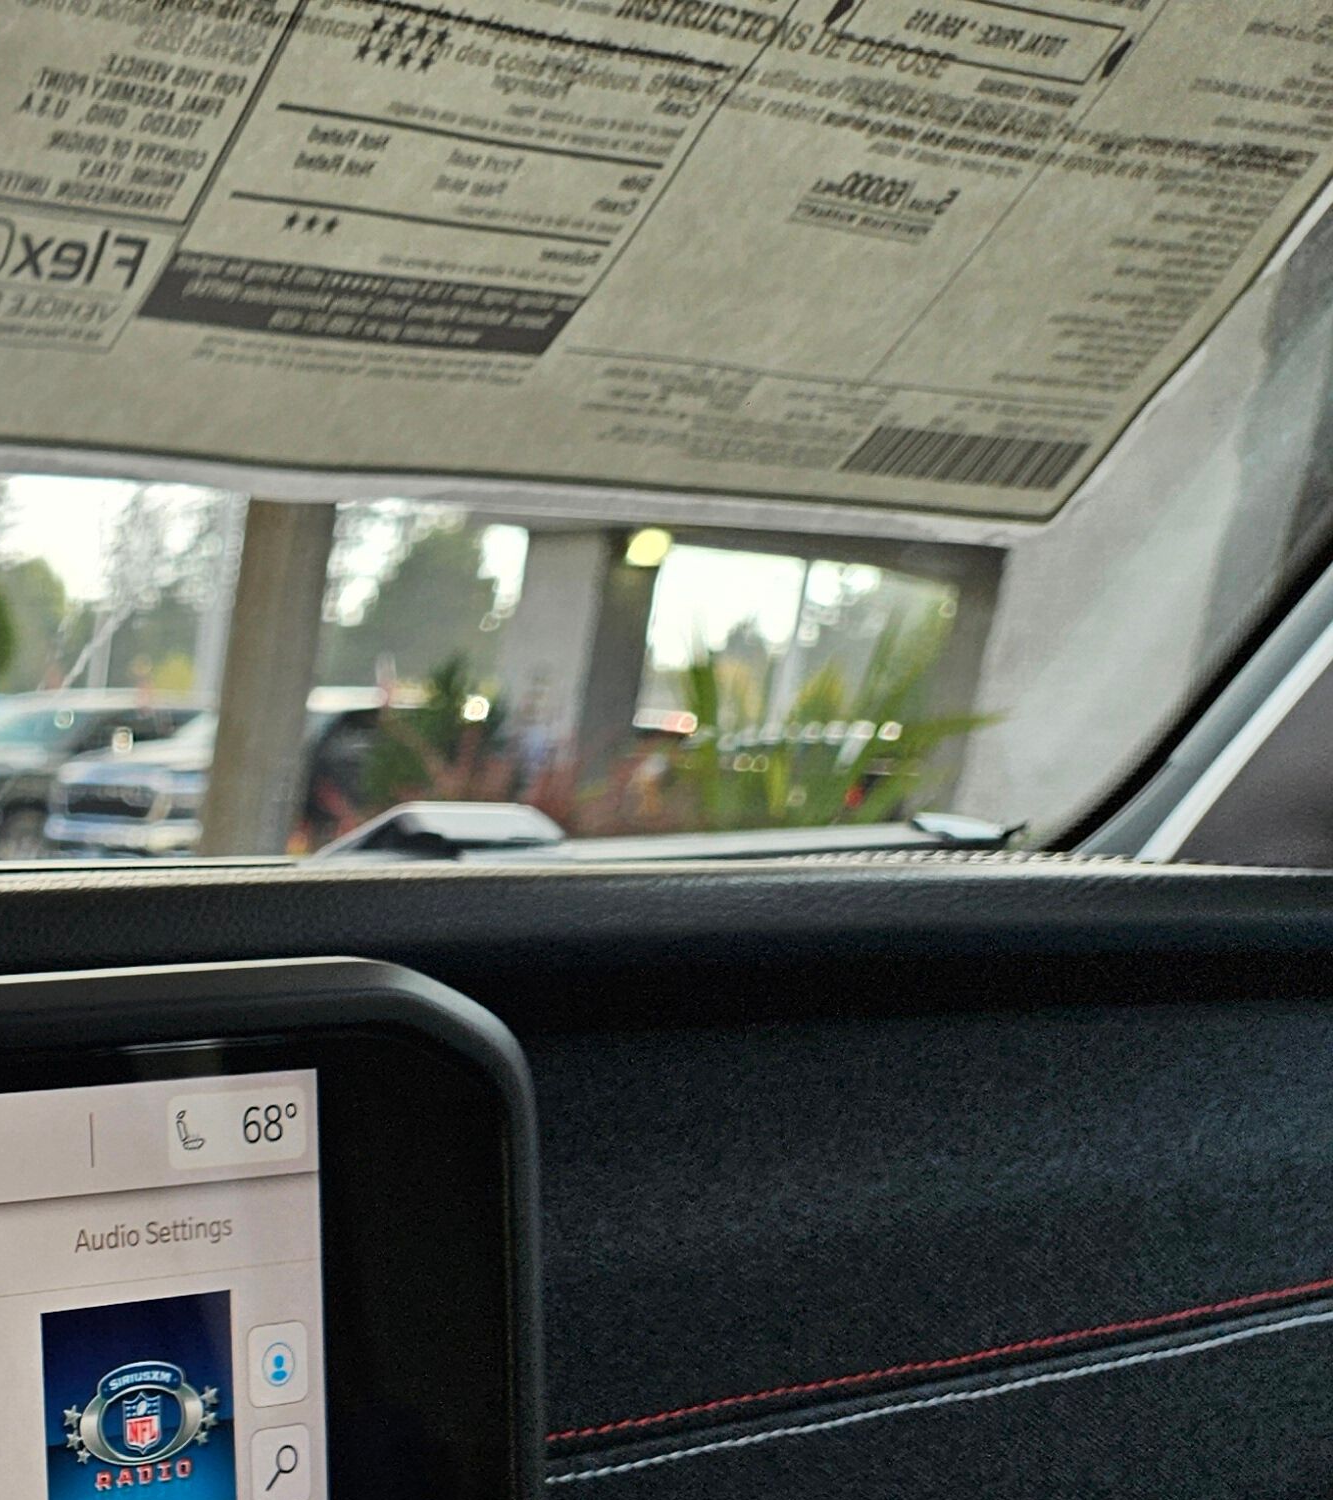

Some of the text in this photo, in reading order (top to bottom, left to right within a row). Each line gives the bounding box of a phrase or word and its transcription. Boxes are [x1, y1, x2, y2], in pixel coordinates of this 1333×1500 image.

[241, 1102, 300, 1146] 68°
[73, 1212, 234, 1256] Audio Settings
[107, 1369, 174, 1394] SIRIUSXM
[125, 1416, 161, 1443] NFL
[93, 1458, 194, 1492] RADIO
